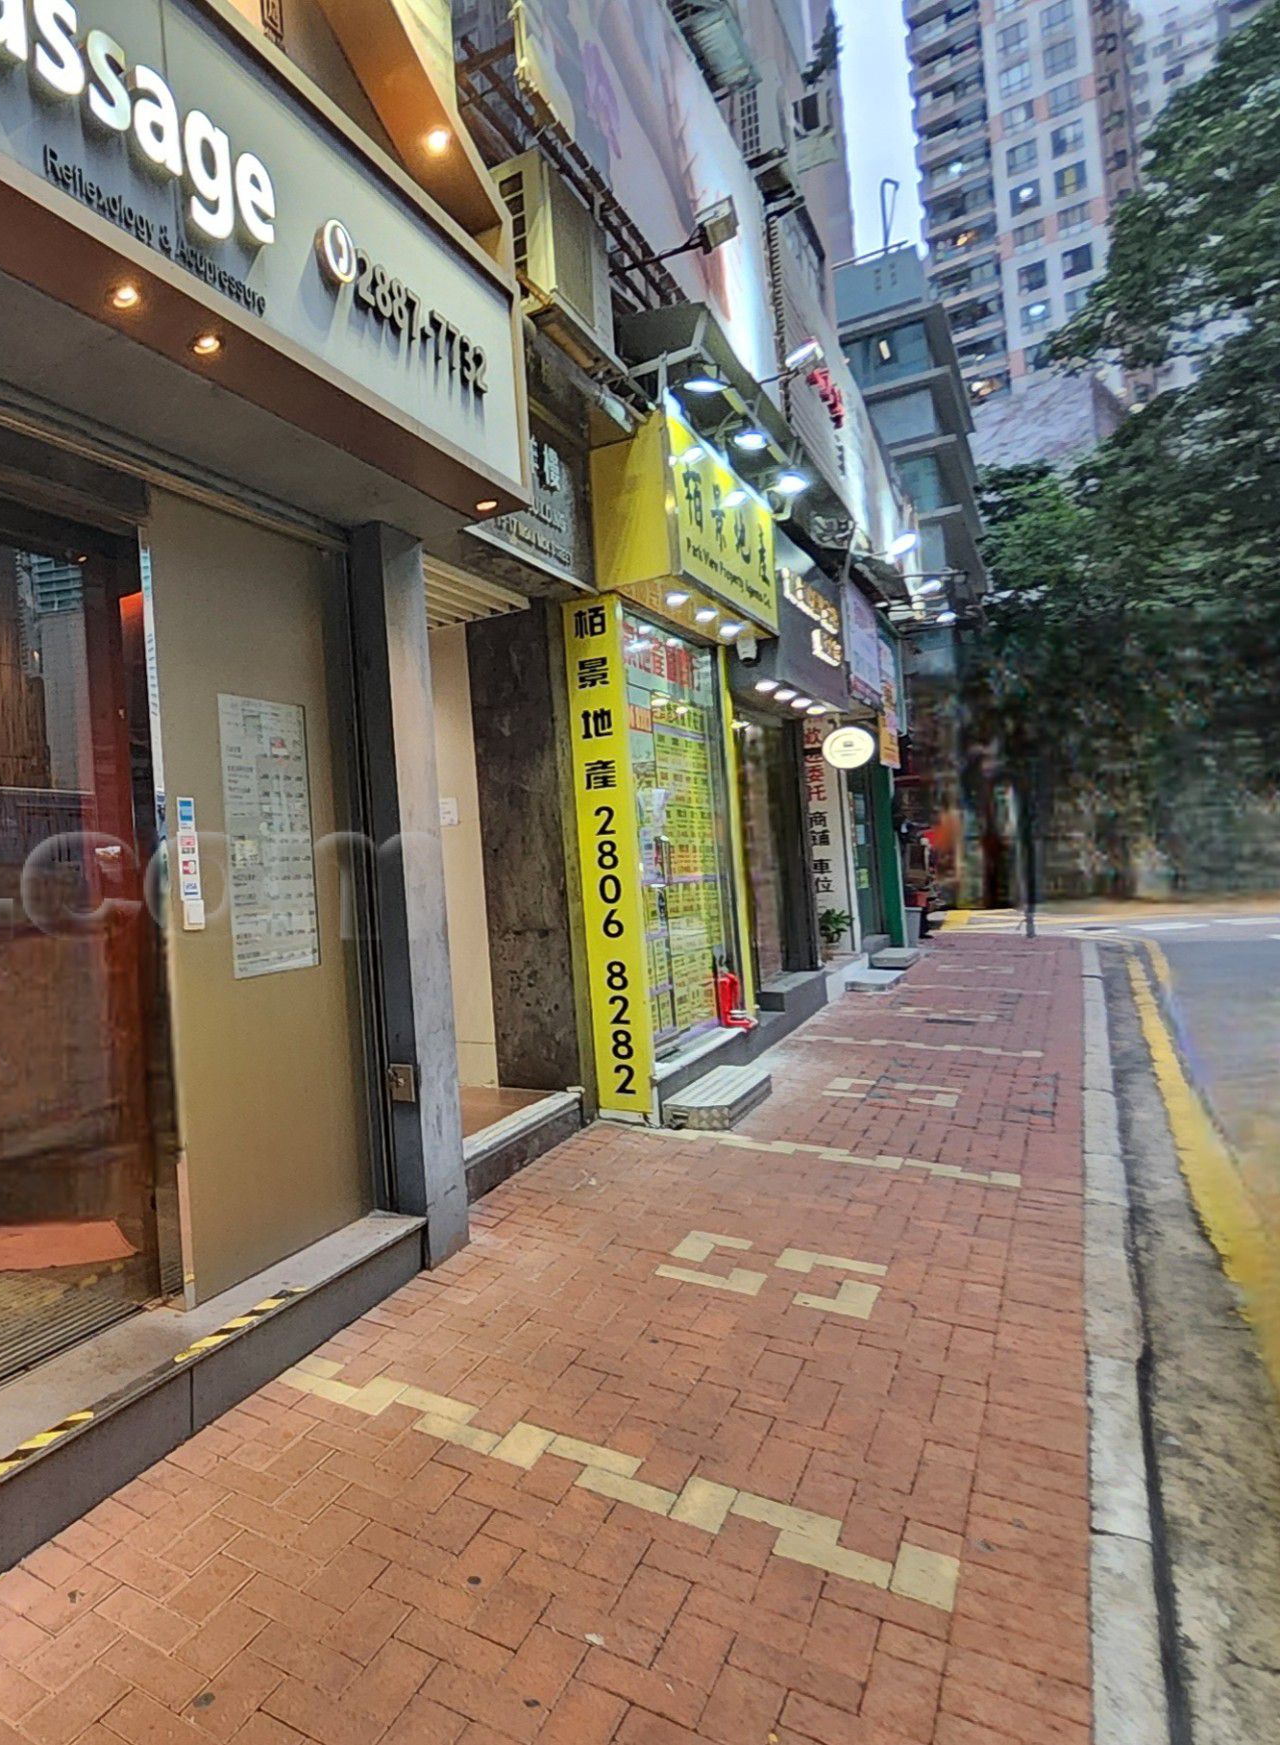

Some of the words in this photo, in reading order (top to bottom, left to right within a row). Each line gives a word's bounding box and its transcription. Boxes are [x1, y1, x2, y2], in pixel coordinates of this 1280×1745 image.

[43, 143, 155, 249] Reflexology
[158, 223, 172, 256] &
[174, 237, 267, 318] Acupressure
[354, 247, 489, 393] 2887-7732
[593, 805, 625, 939] 2806
[812, 858, 835, 894] 車位
[606, 960, 637, 1096] 8282
